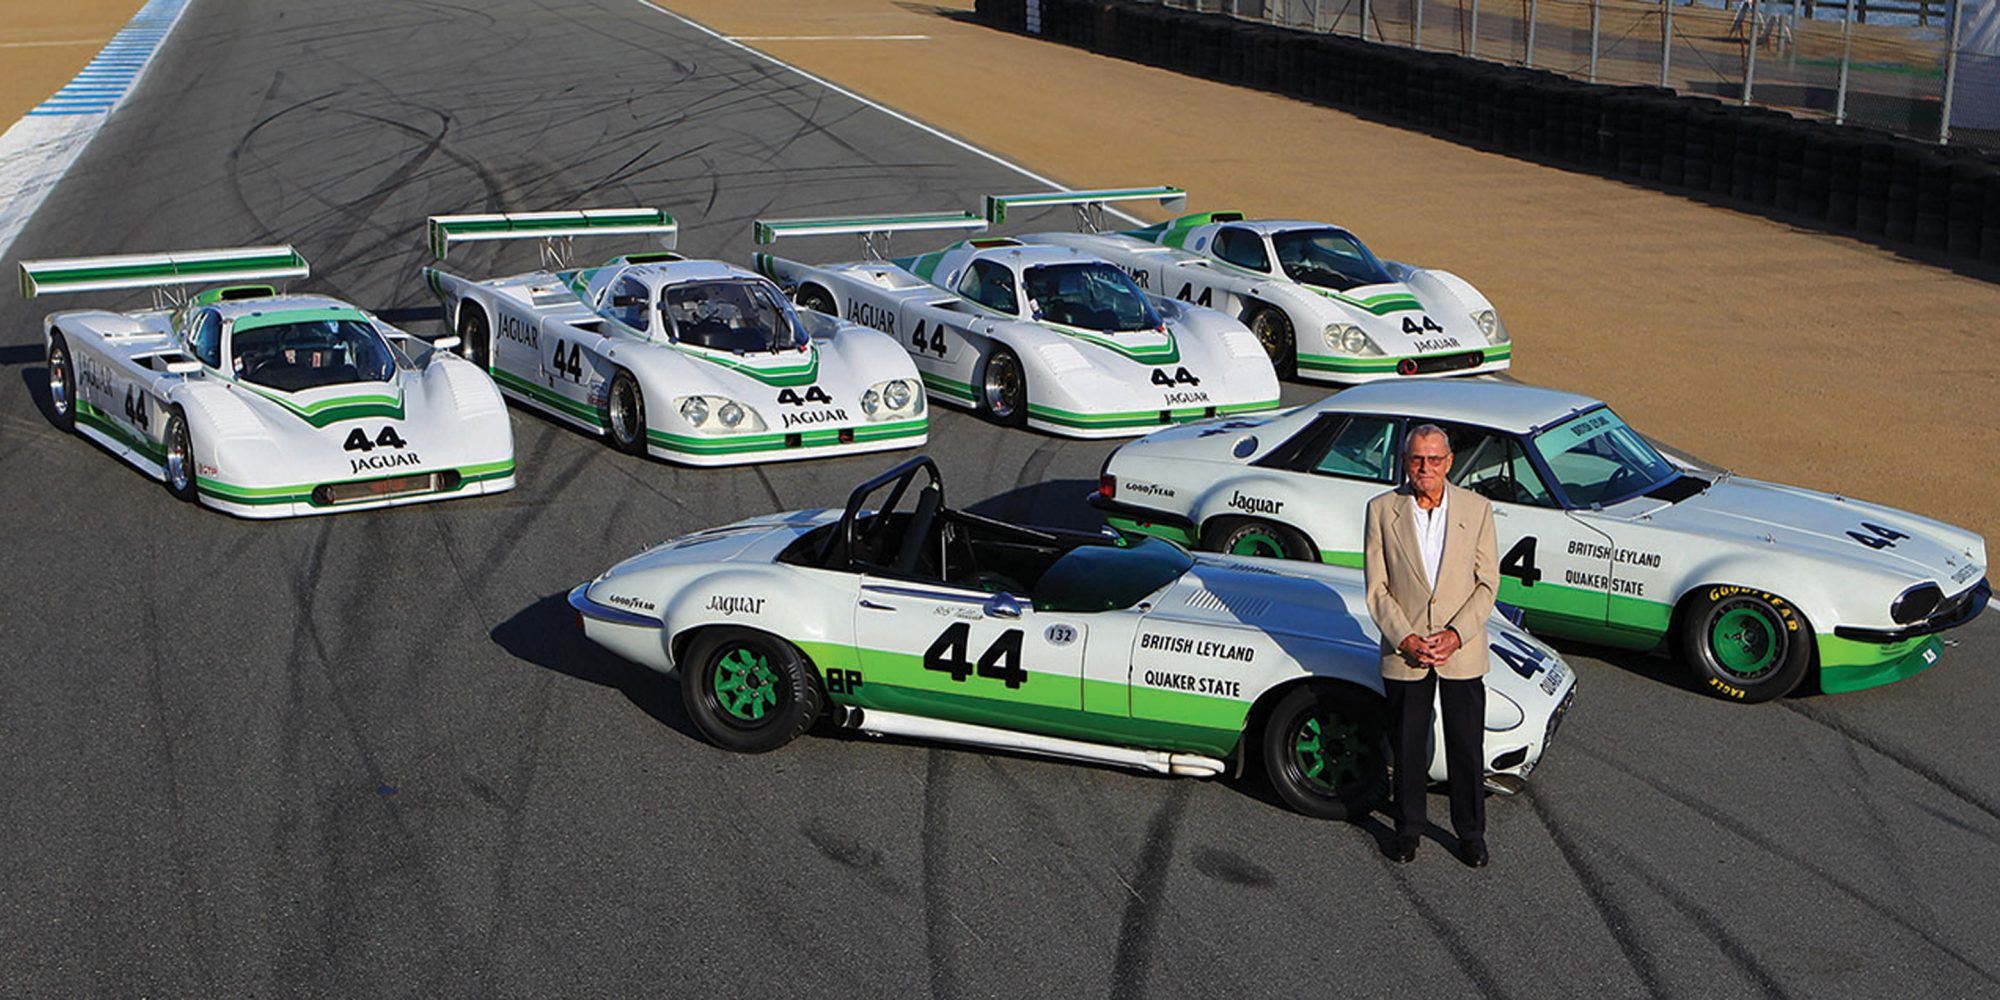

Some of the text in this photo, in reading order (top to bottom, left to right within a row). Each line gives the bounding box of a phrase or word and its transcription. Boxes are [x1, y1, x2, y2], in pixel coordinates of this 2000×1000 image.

[847, 298, 894, 335] JAGUAR
[1402, 316, 1443, 335] 44
[497, 313, 538, 350] JAGUAR
[912, 319, 948, 359] 44
[1413, 338, 1461, 354] JAGUAR
[553, 339, 582, 383] 44
[1151, 366, 1200, 388] 44
[125, 384, 149, 432] 44
[777, 386, 833, 406] 44
[1164, 392, 1210, 406] JAGUAR
[782, 409, 848, 428] JAGUAR
[343, 426, 407, 451] 44
[350, 453, 421, 474] JAGUAR
[1228, 490, 1284, 515] Jaguar
[1846, 522, 1910, 550] 44
[1567, 541, 1662, 568] BRITISH LEYLAND
[1565, 570, 1644, 596] QUAKER STATE
[705, 594, 765, 616] Jaguar
[1049, 627, 1072, 642] 132
[1141, 633, 1255, 662] BRITISH LEYLAND
[923, 622, 1028, 690] 44
[1489, 631, 1553, 680] 44
[826, 667, 863, 695] BP
[1145, 670, 1241, 698] QUAKER STATE
[1709, 678, 1746, 699] EAGLE
